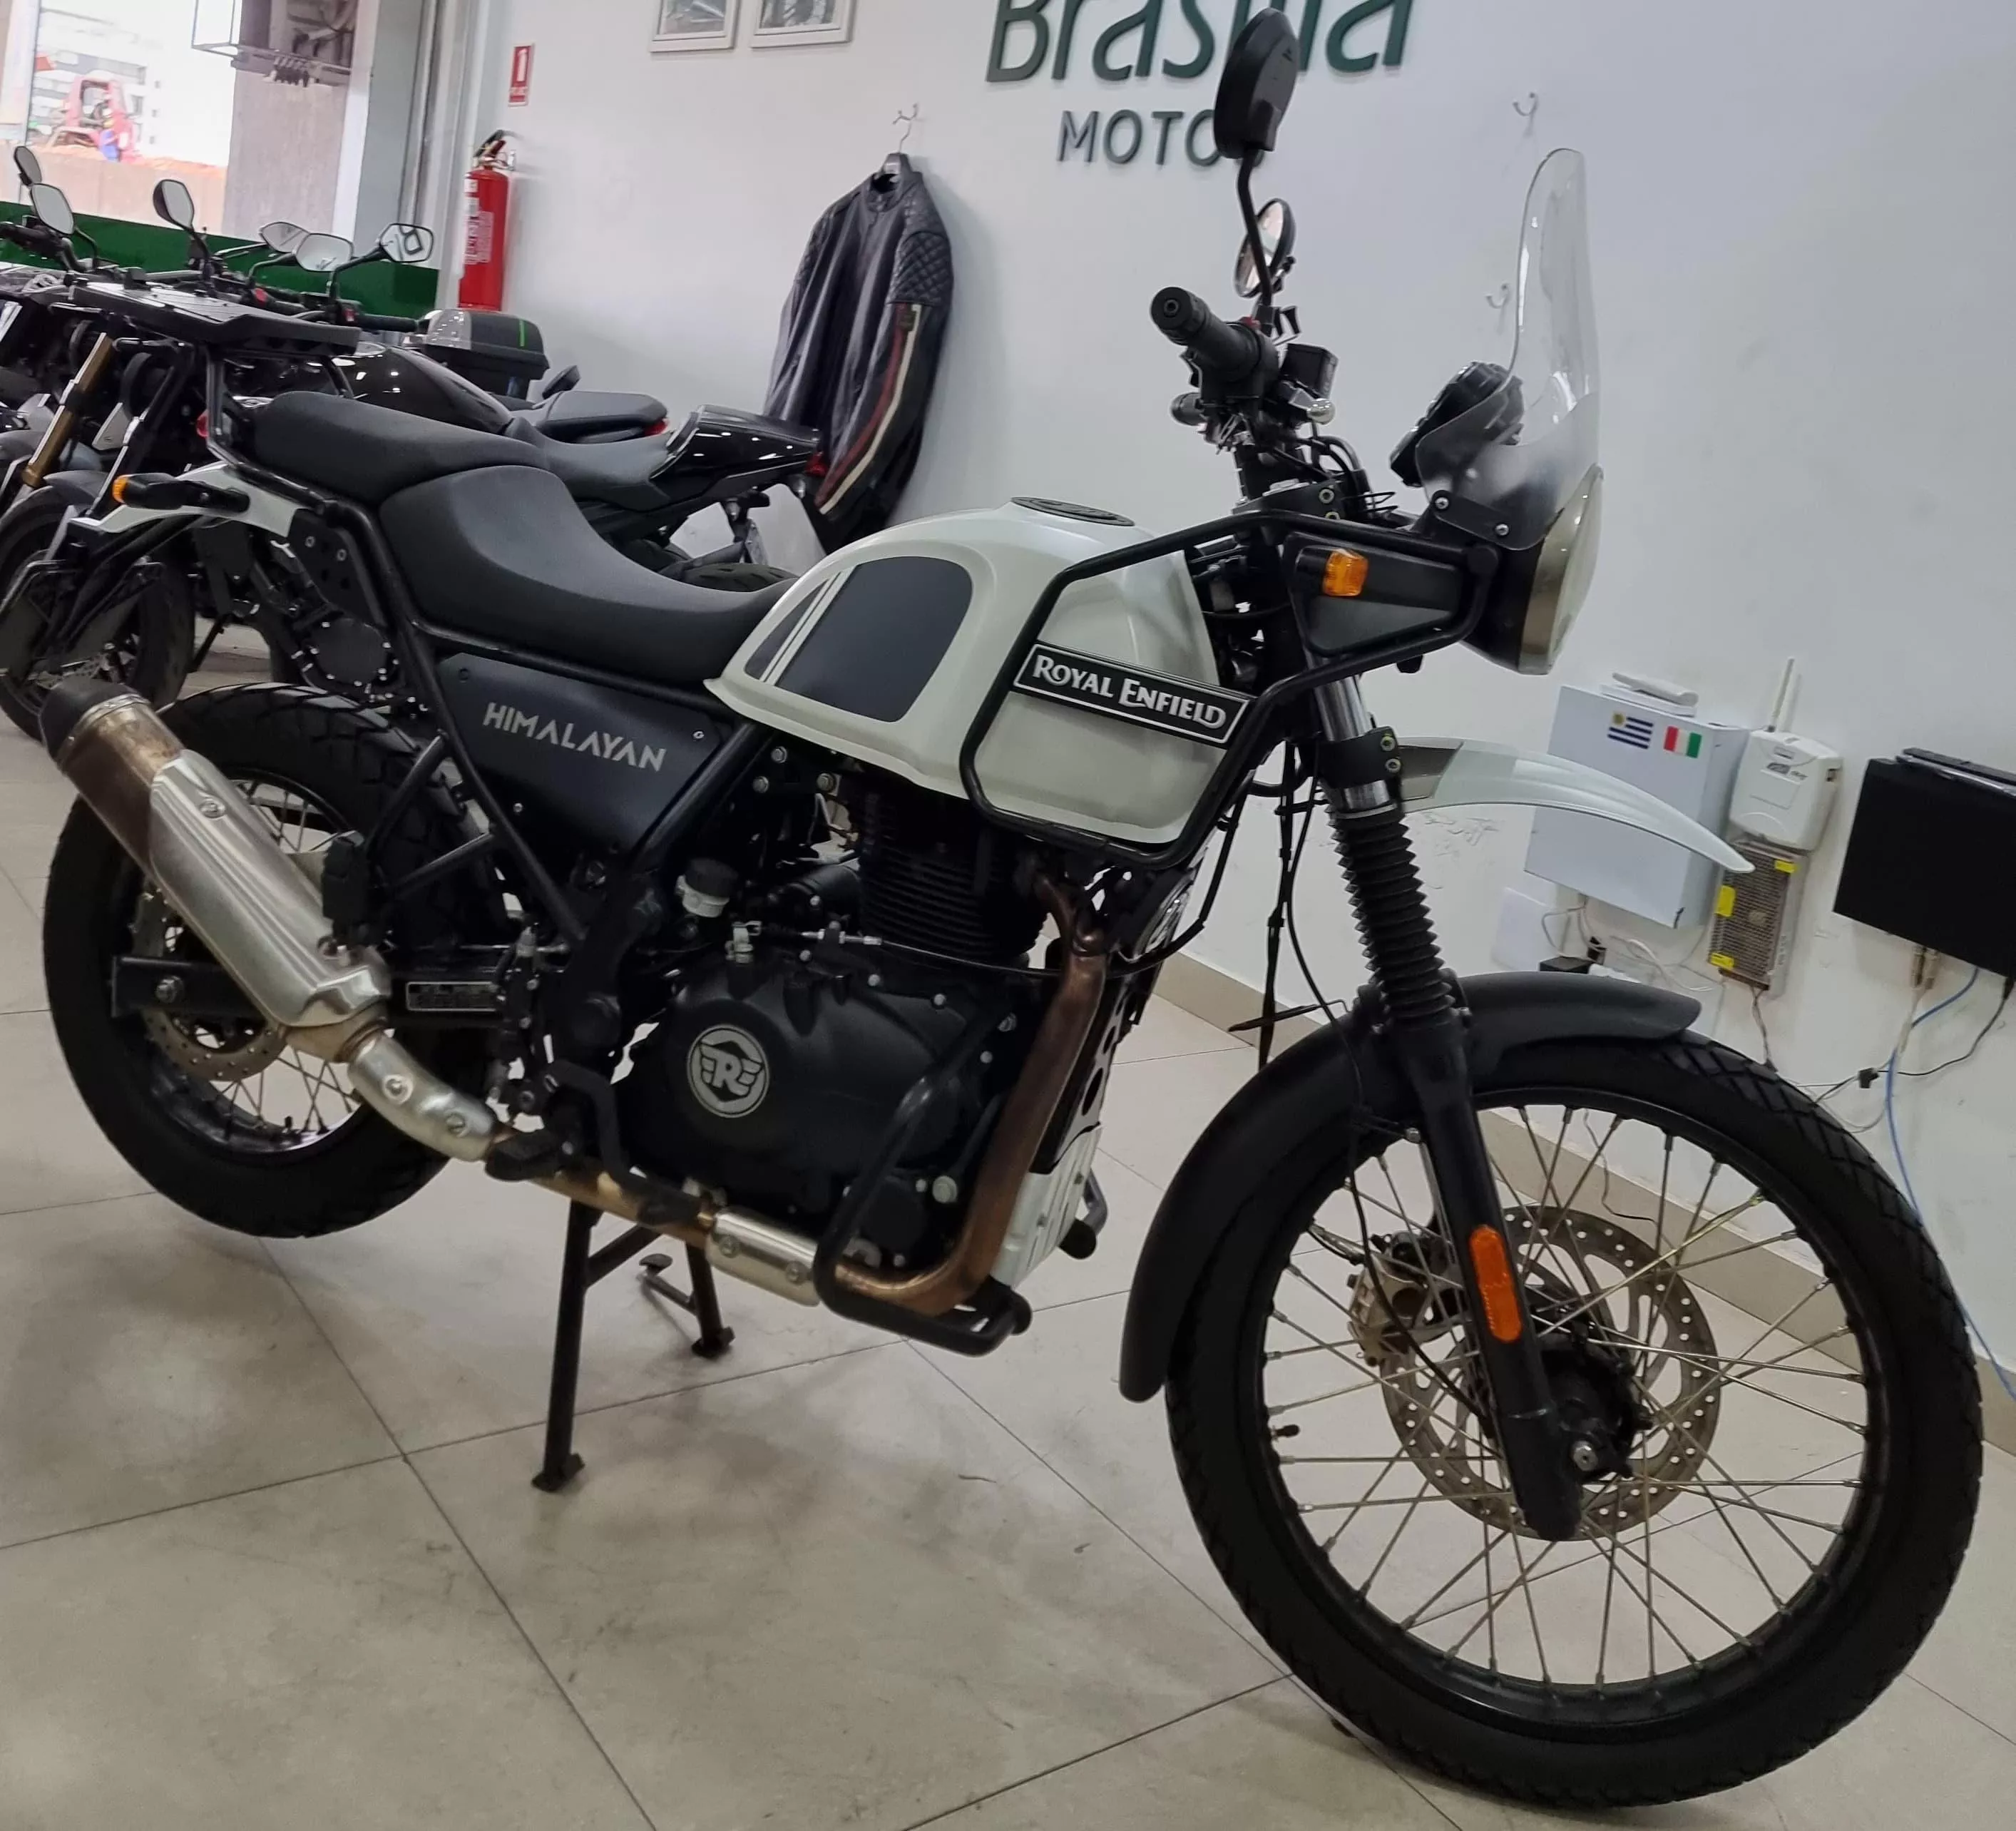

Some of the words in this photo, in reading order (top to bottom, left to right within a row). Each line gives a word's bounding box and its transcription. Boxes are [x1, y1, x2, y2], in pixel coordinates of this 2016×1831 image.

[1057, 109, 1264, 167] MOTO
[1033, 654, 1114, 698] ROYAL
[1118, 678, 1227, 729] ENFIELD
[482, 702, 667, 772] HIMALAYAN
